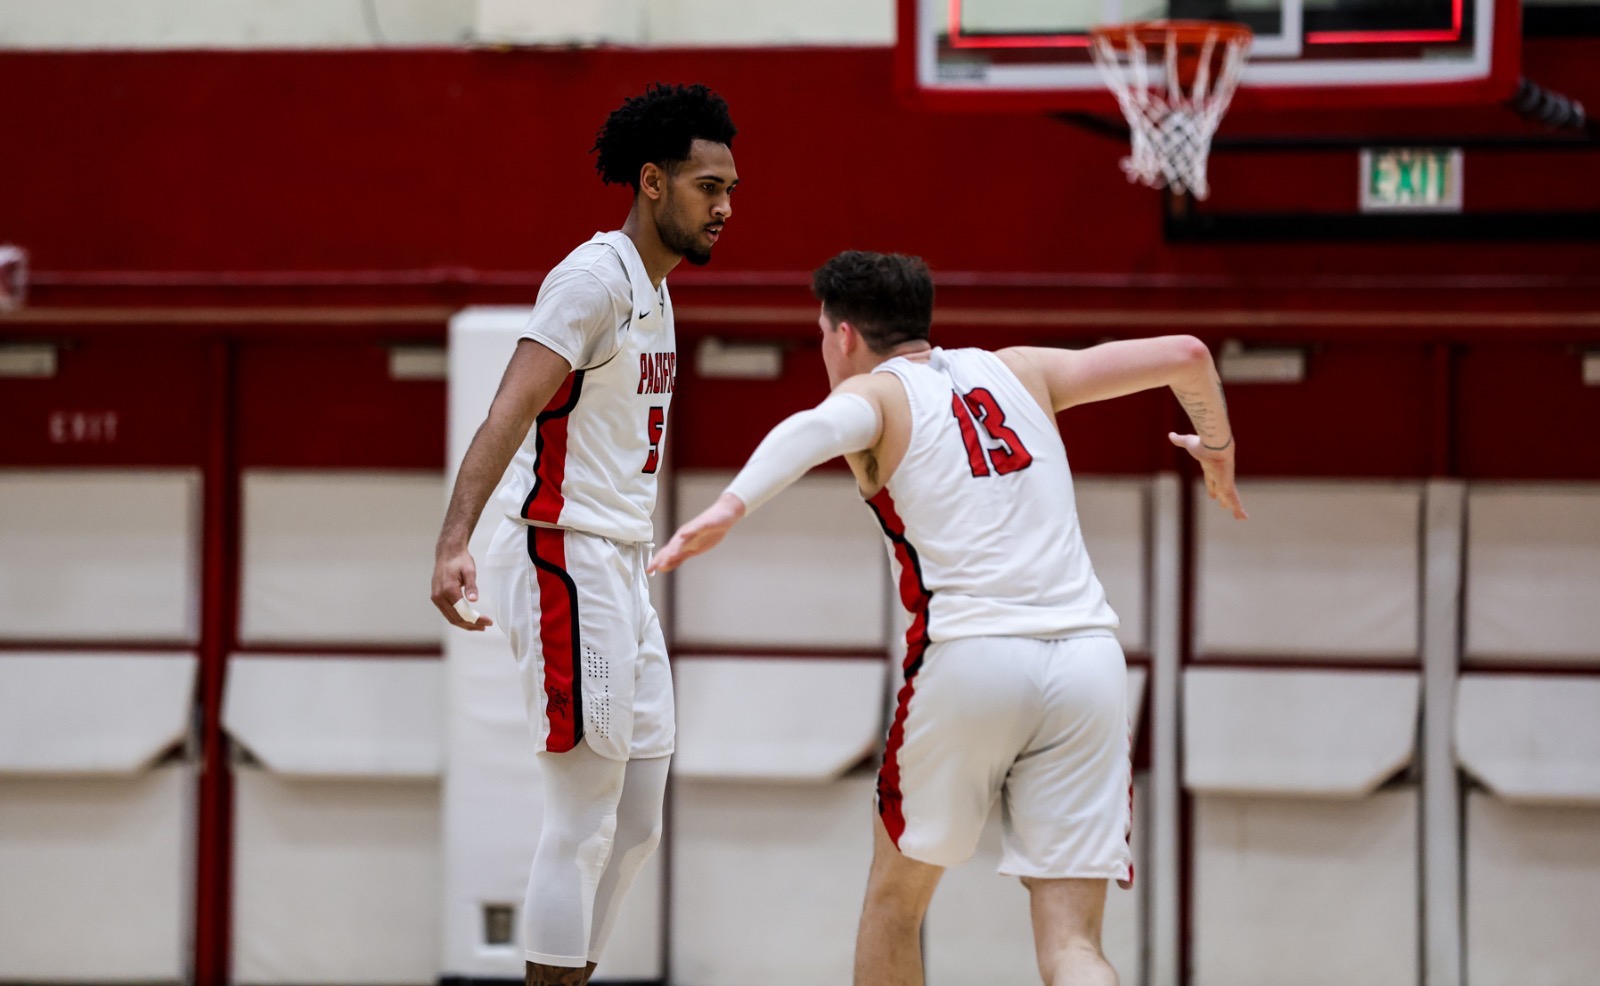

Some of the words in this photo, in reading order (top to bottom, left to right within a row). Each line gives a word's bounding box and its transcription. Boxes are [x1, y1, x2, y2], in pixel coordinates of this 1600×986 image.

[1369, 150, 1449, 202] EXIT
[49, 411, 118, 442] EXIT
[641, 406, 664, 474] 5
[951, 387, 1033, 478] 13
